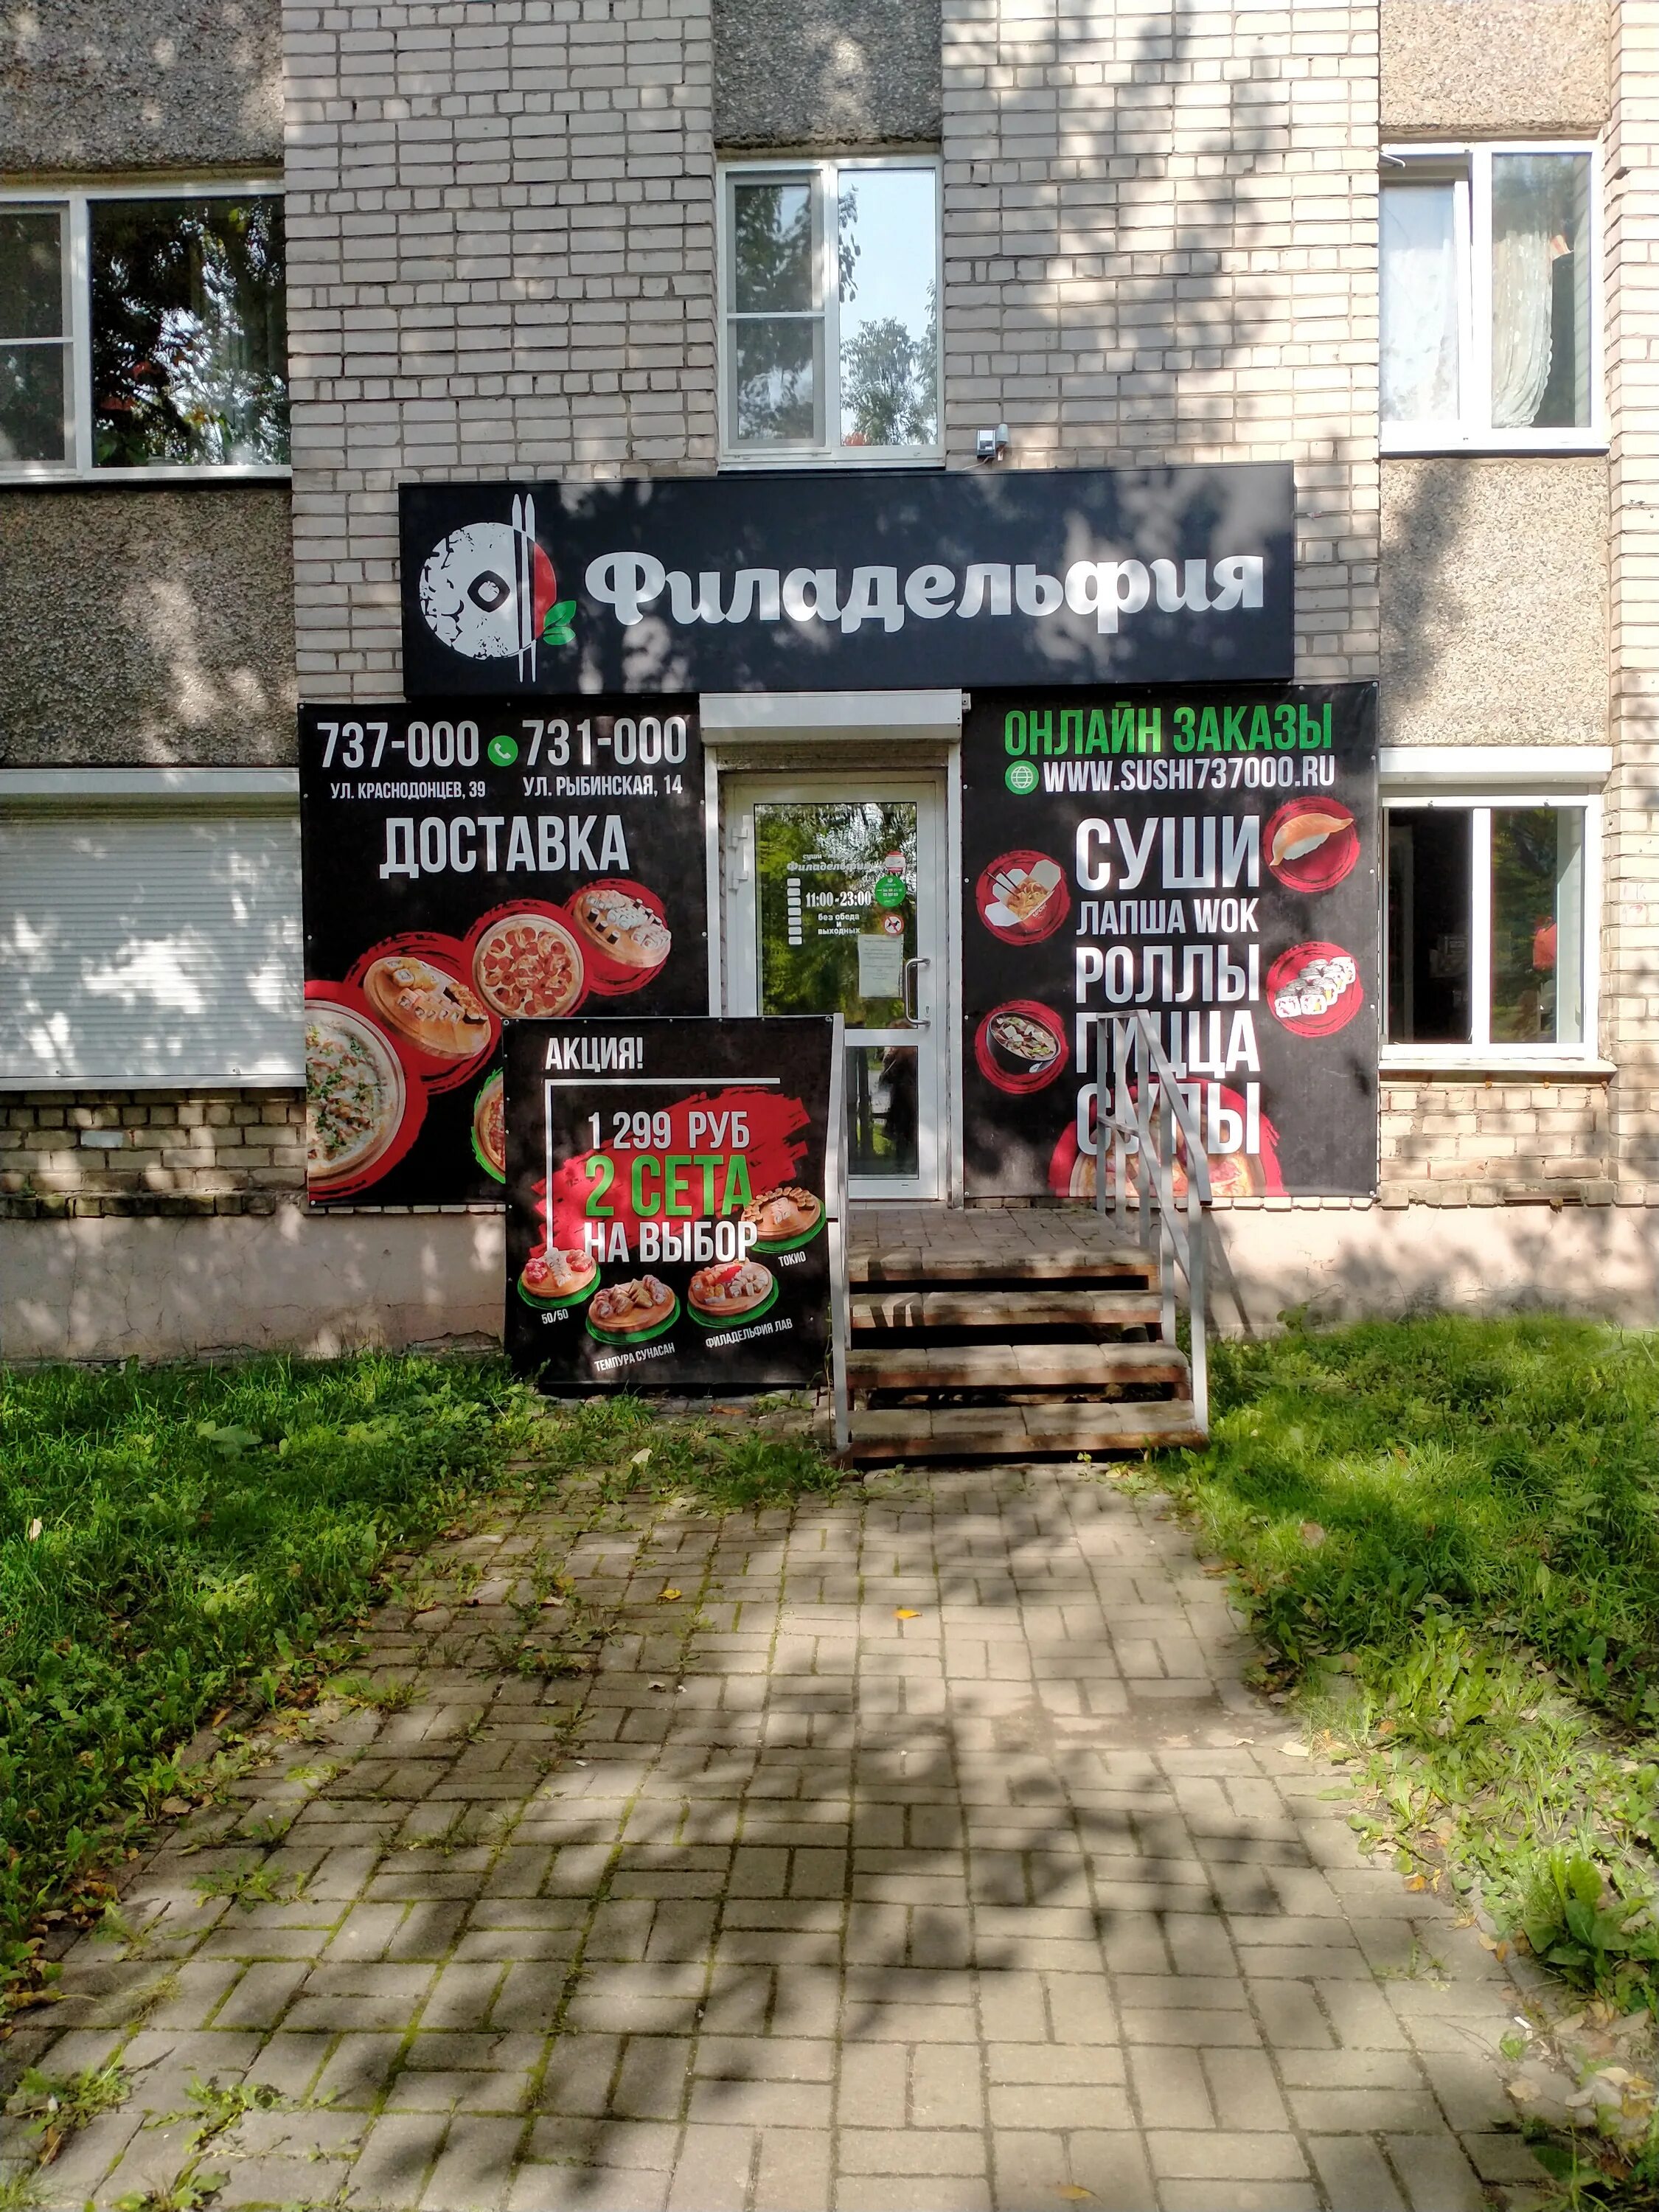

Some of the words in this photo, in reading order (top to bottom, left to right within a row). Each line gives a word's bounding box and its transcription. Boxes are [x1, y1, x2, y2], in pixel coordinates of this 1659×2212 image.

[585, 552, 1264, 634] Филадельфия
[317, 721, 479, 768] 737-000
[522, 717, 687, 766] 731-000
[1005, 702, 1161, 755] ОНЛАЙН
[1173, 703, 1332, 753] ЗАКАЗЫ
[330, 782, 355, 799] УЛ.
[358, 782, 466, 800] КРАСНОДОНЦЕВ,
[469, 781, 486, 798] 39
[523, 776, 552, 796] УЛ.
[556, 775, 658, 797] РЫБИНСКАЯ,
[664, 774, 683, 794] 14
[1043, 755, 1335, 792] WWW.SUSHI737000.RU
[380, 815, 630, 879] ДОСТАВКА
[1076, 815, 1259, 891] СУШИ
[818, 913, 833, 921] без
[835, 912, 860, 921] обеда
[1077, 900, 1186, 936] ЛАПША
[1194, 897, 1259, 933] WOK
[1076, 944, 1259, 1004] РОЛЛЫ
[545, 1037, 644, 1073] АКЦИЯ!
[689, 1111, 750, 1149] РУБ
[585, 1155, 616, 1217] 2
[631, 1155, 754, 1217] СЕТА
[585, 1222, 630, 1263] НА
[639, 1221, 757, 1263] ВЫБОР
[778, 1251, 807, 1267] ТОКИО
[541, 1309, 569, 1325] 50/50
[705, 1322, 773, 1349] ФИЛАДЕЛЬФИЯ
[775, 1318, 793, 1332] ЛАВ
[594, 1353, 636, 1372] ТЕМПУРА
[635, 1342, 675, 1362] СУНАСАН
